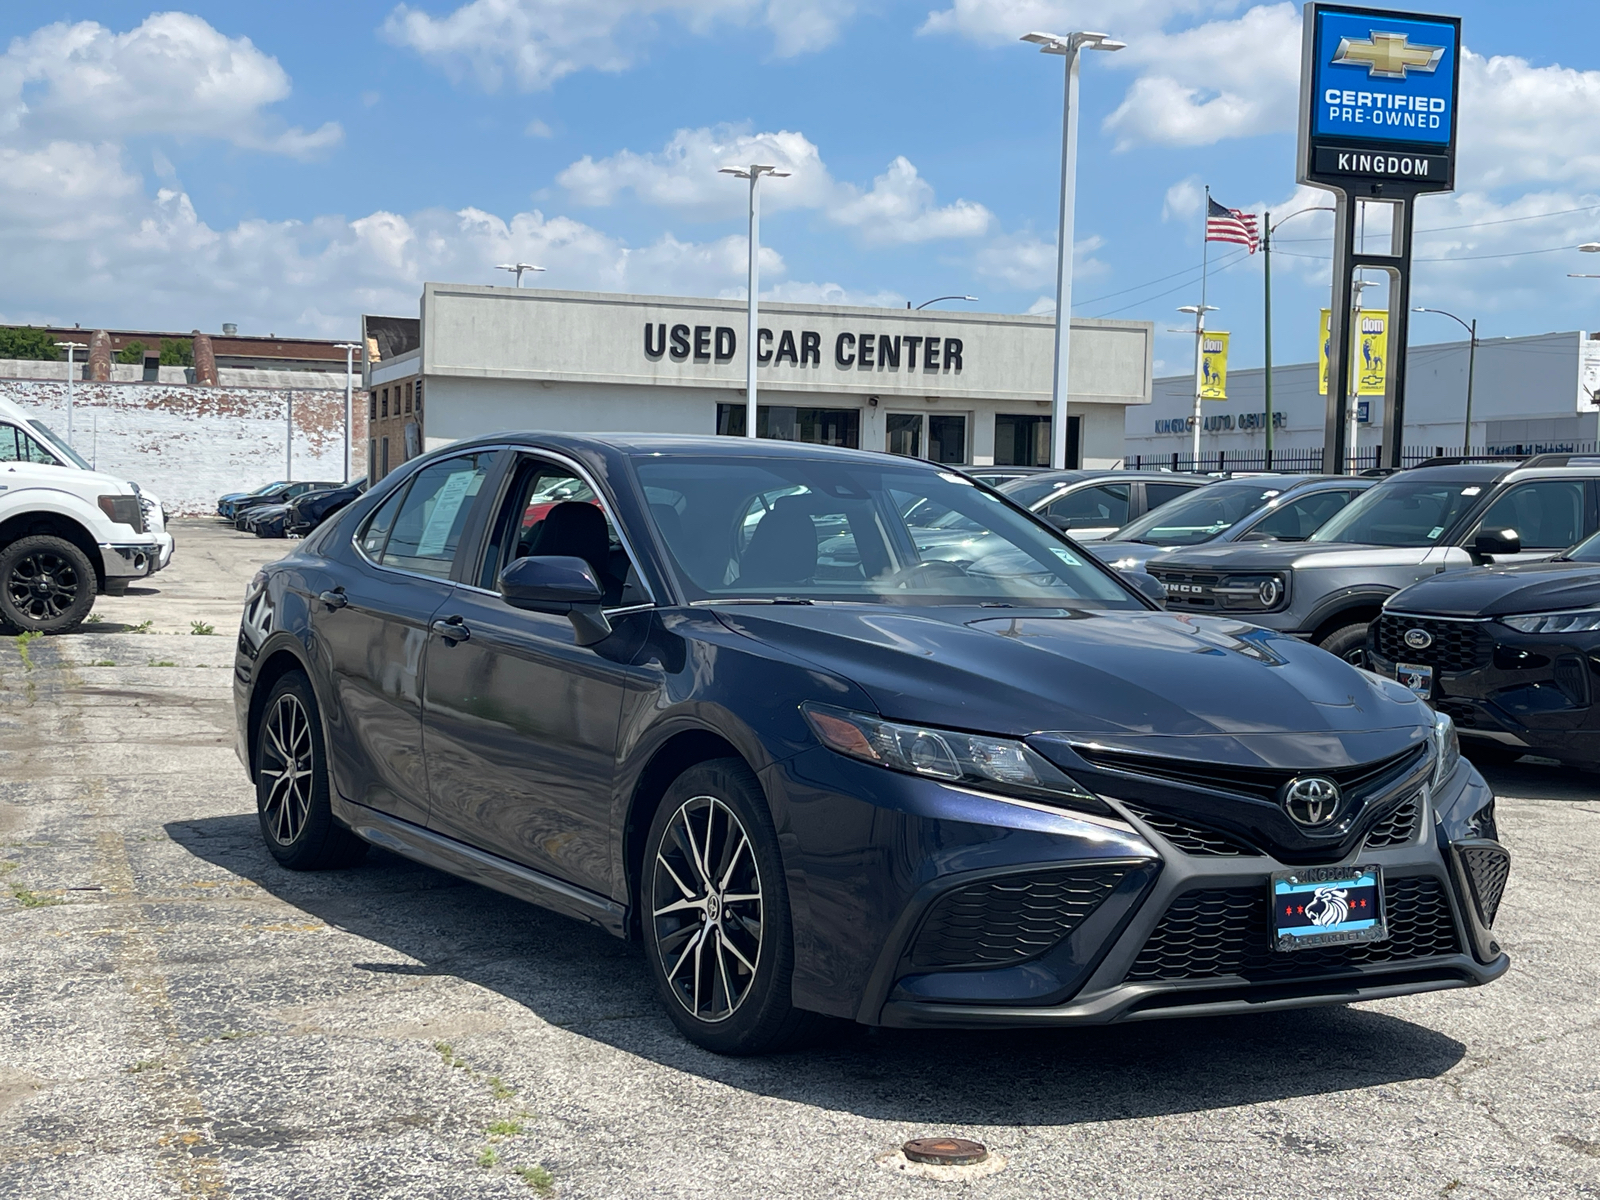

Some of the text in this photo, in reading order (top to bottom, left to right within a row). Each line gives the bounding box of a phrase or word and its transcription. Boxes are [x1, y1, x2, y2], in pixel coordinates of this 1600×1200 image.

[1325, 89, 1445, 113] CERTIFIED
[1329, 106, 1440, 129] PRE-OWNED
[1338, 153, 1429, 176] KINGDOM
[1362, 316, 1384, 335] dom
[644, 323, 964, 372] USED CAR CENTER
[1203, 338, 1223, 353] dom
[1154, 417, 1201, 434] KINGDO
[1203, 414, 1236, 431] AUTO
[1161, 583, 1202, 593] ONCO
[1298, 867, 1354, 882] KINGDOM
